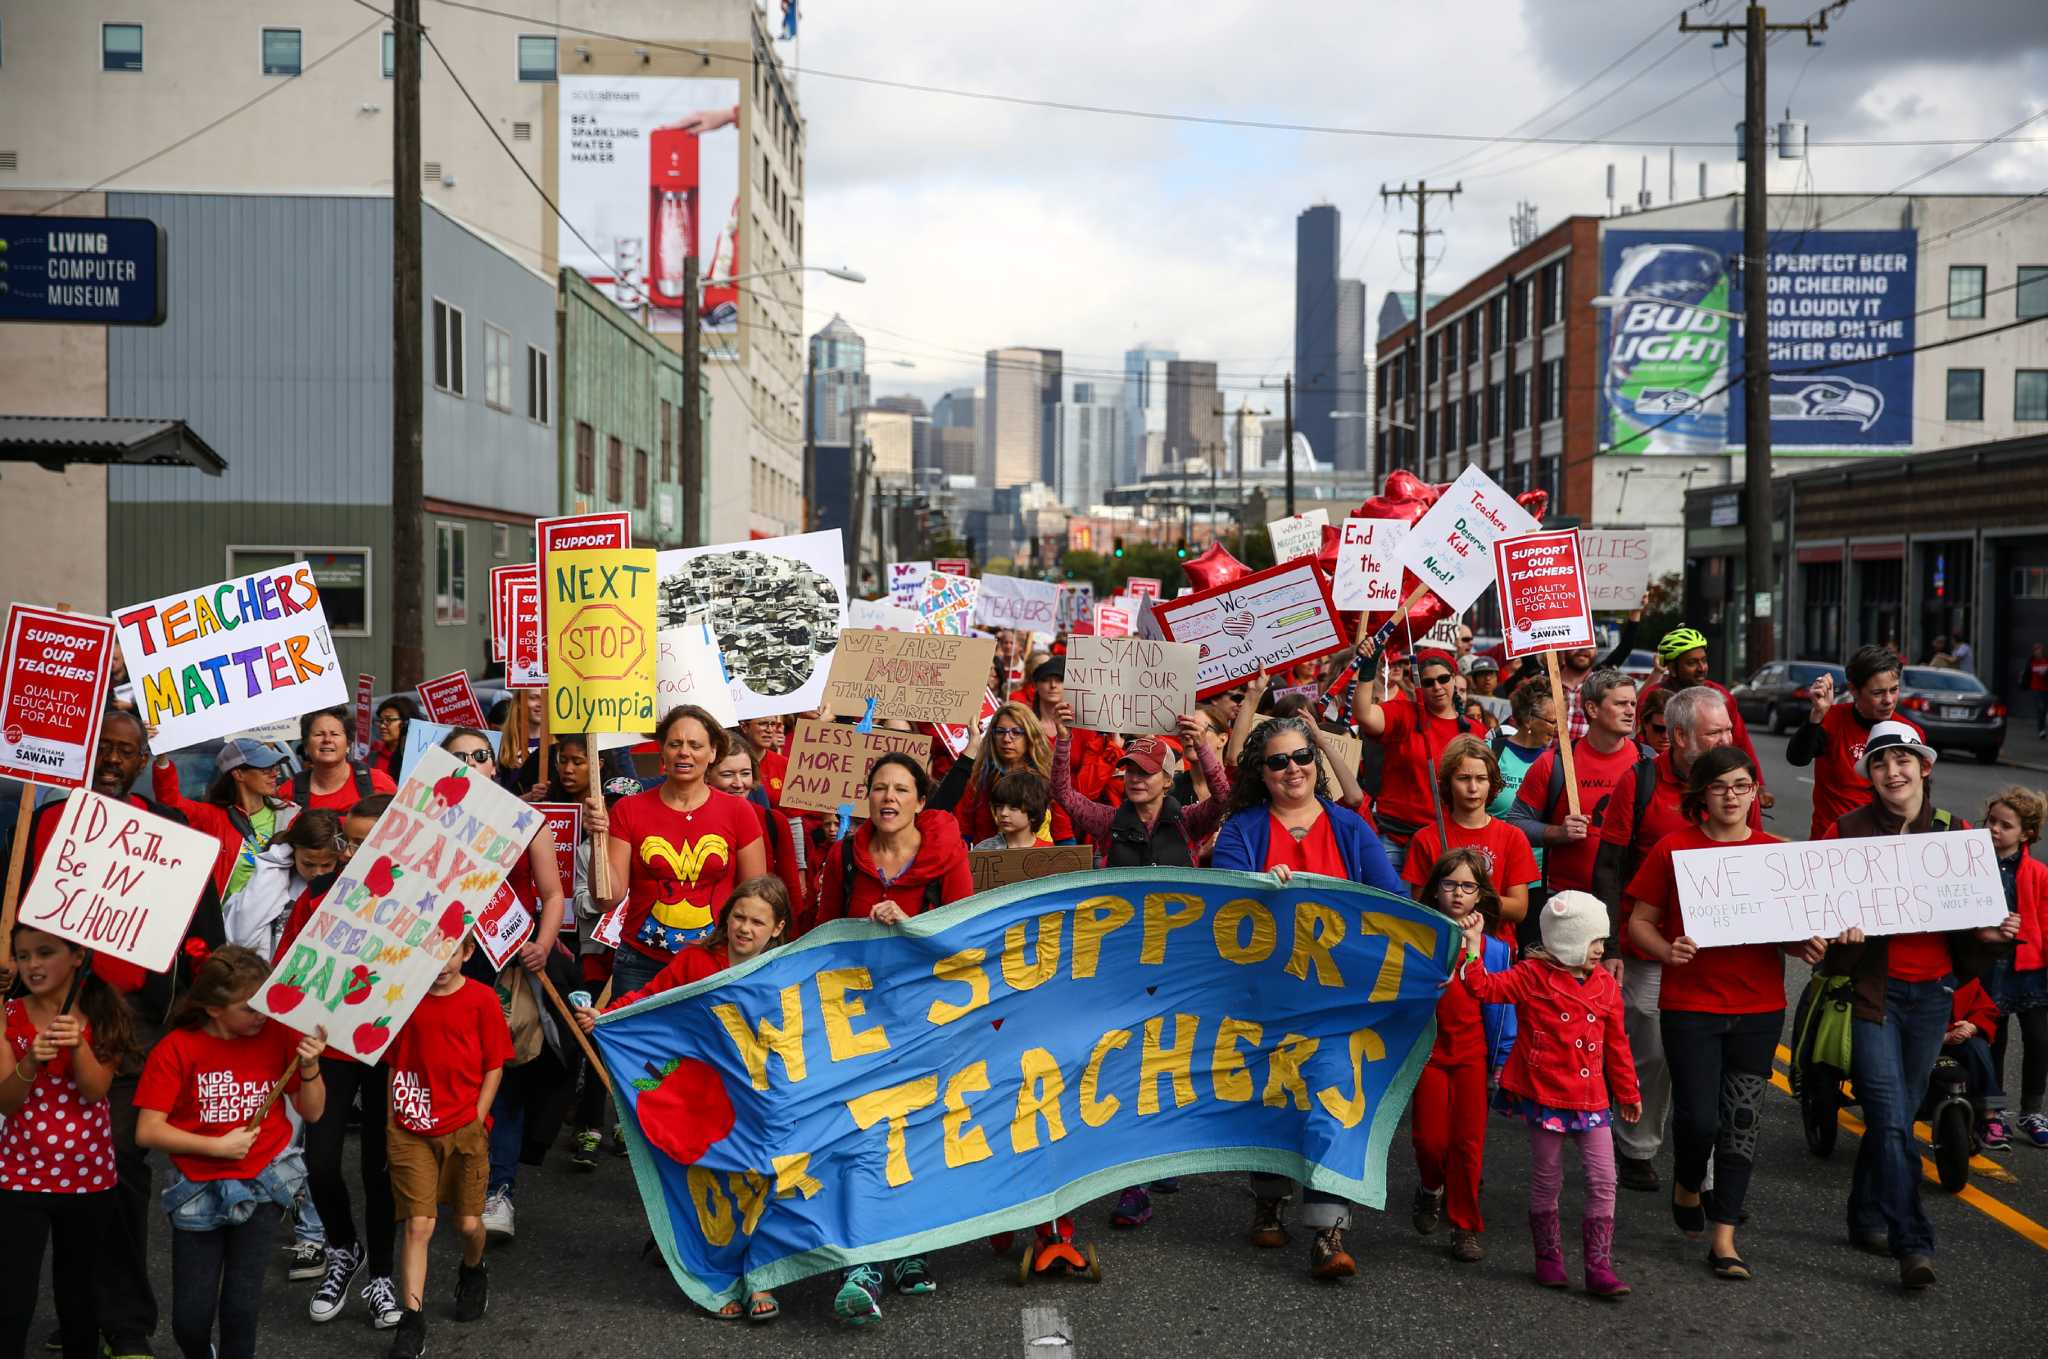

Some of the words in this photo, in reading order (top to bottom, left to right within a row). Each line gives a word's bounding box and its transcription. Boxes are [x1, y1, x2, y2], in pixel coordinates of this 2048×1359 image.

[572, 127, 640, 138] SPARKLING
[572, 140, 614, 150] WATER
[572, 153, 615, 163] MAKER
[48, 233, 108, 254] LIVING
[48, 259, 136, 281] COMPUTER
[1775, 253, 1857, 272] PERFECT
[1859, 254, 1908, 273] BEER
[48, 285, 120, 307] MUSEUM
[1766, 276, 1792, 294] OR
[1794, 276, 1888, 294] CHEERING
[1623, 302, 1721, 333] BUD
[1790, 298, 1860, 316] LOUDLY
[1863, 299, 1882, 316] IT
[1839, 320, 1866, 338] ON
[1868, 320, 1904, 339] THE
[1612, 333, 1727, 363] LIGHT
[1767, 342, 1826, 360] CHTER
[1470, 489, 1508, 532] Teachers
[554, 532, 615, 550] SUPPORT
[1344, 524, 1375, 545] End
[1446, 532, 1469, 558] Kids
[1454, 517, 1488, 556] Deserve,
[1360, 554, 1381, 573] the
[1511, 545, 1568, 560] SUPPORT
[1528, 557, 1554, 567] OUR
[1423, 556, 1455, 586] Need!
[1511, 566, 1575, 582] TEACHERS
[556, 564, 650, 604] NEXT
[1366, 579, 1398, 600] Srike
[1521, 584, 1567, 596] QUALITY
[983, 593, 1056, 623] TEACHERS
[1215, 591, 1249, 614] We
[1515, 592, 1576, 607] EDUCATION
[1524, 603, 1546, 612] FOR
[119, 568, 320, 657] TEACHERS
[25, 627, 98, 652] SUPPORT
[568, 625, 636, 661] STOP
[1530, 628, 1571, 640] SAWANT
[42, 647, 75, 663] OUR
[843, 633, 889, 654] WE
[896, 637, 962, 662] ARE
[1068, 636, 1089, 661] I
[1098, 637, 1163, 668] STAND
[1228, 639, 1254, 657] our
[18, 657, 96, 683] TEACHERS
[141, 625, 336, 727] MATTER!
[865, 657, 950, 687] MORE
[1067, 668, 1120, 687] WITH
[1139, 670, 1179, 691] OUR
[24, 684, 80, 704] QUALITY
[832, 681, 886, 701] THAN
[893, 685, 906, 700] A
[915, 687, 970, 708] TEST
[12, 695, 87, 718] EDUCATION
[435, 699, 471, 715] TEACHERS
[556, 686, 653, 733] Olympia
[20, 709, 46, 724] FOR
[47, 714, 74, 729] ALL
[804, 725, 853, 748] LESS
[862, 732, 930, 756] TESTING
[15, 748, 66, 768] SAWANT
[797, 750, 855, 773] MORE
[787, 774, 831, 795] AND
[70, 793, 108, 843] I'D
[396, 776, 465, 829] KIDS
[455, 815, 524, 870] NEED
[368, 807, 478, 894] PLAY
[56, 838, 87, 877] Be
[102, 861, 145, 897] IN
[1683, 855, 1749, 900] WE
[1764, 842, 1909, 893] SUPPORT
[1921, 838, 1991, 879] OUR
[333, 876, 461, 961] TEACHERS
[1688, 900, 1765, 920] ROOSEVELT
[1775, 883, 1933, 932] TEACHERS
[500, 913, 526, 942] SAWANT
[1712, 917, 1731, 928] HS
[306, 911, 385, 964] NEED
[276, 942, 368, 1013] PAY
[711, 967, 890, 1091] WE
[926, 892, 1438, 1026] SUPPORT
[197, 1070, 234, 1085] KIDS
[392, 1070, 419, 1087] AM
[198, 1082, 240, 1098] NEED
[392, 1086, 431, 1103] ORE
[199, 1094, 269, 1110] TEACHER
[393, 1100, 431, 1119] HAN
[199, 1109, 240, 1123] NEED
[686, 1151, 825, 1248] OUR
[845, 1014, 1387, 1188] TEACHERS
